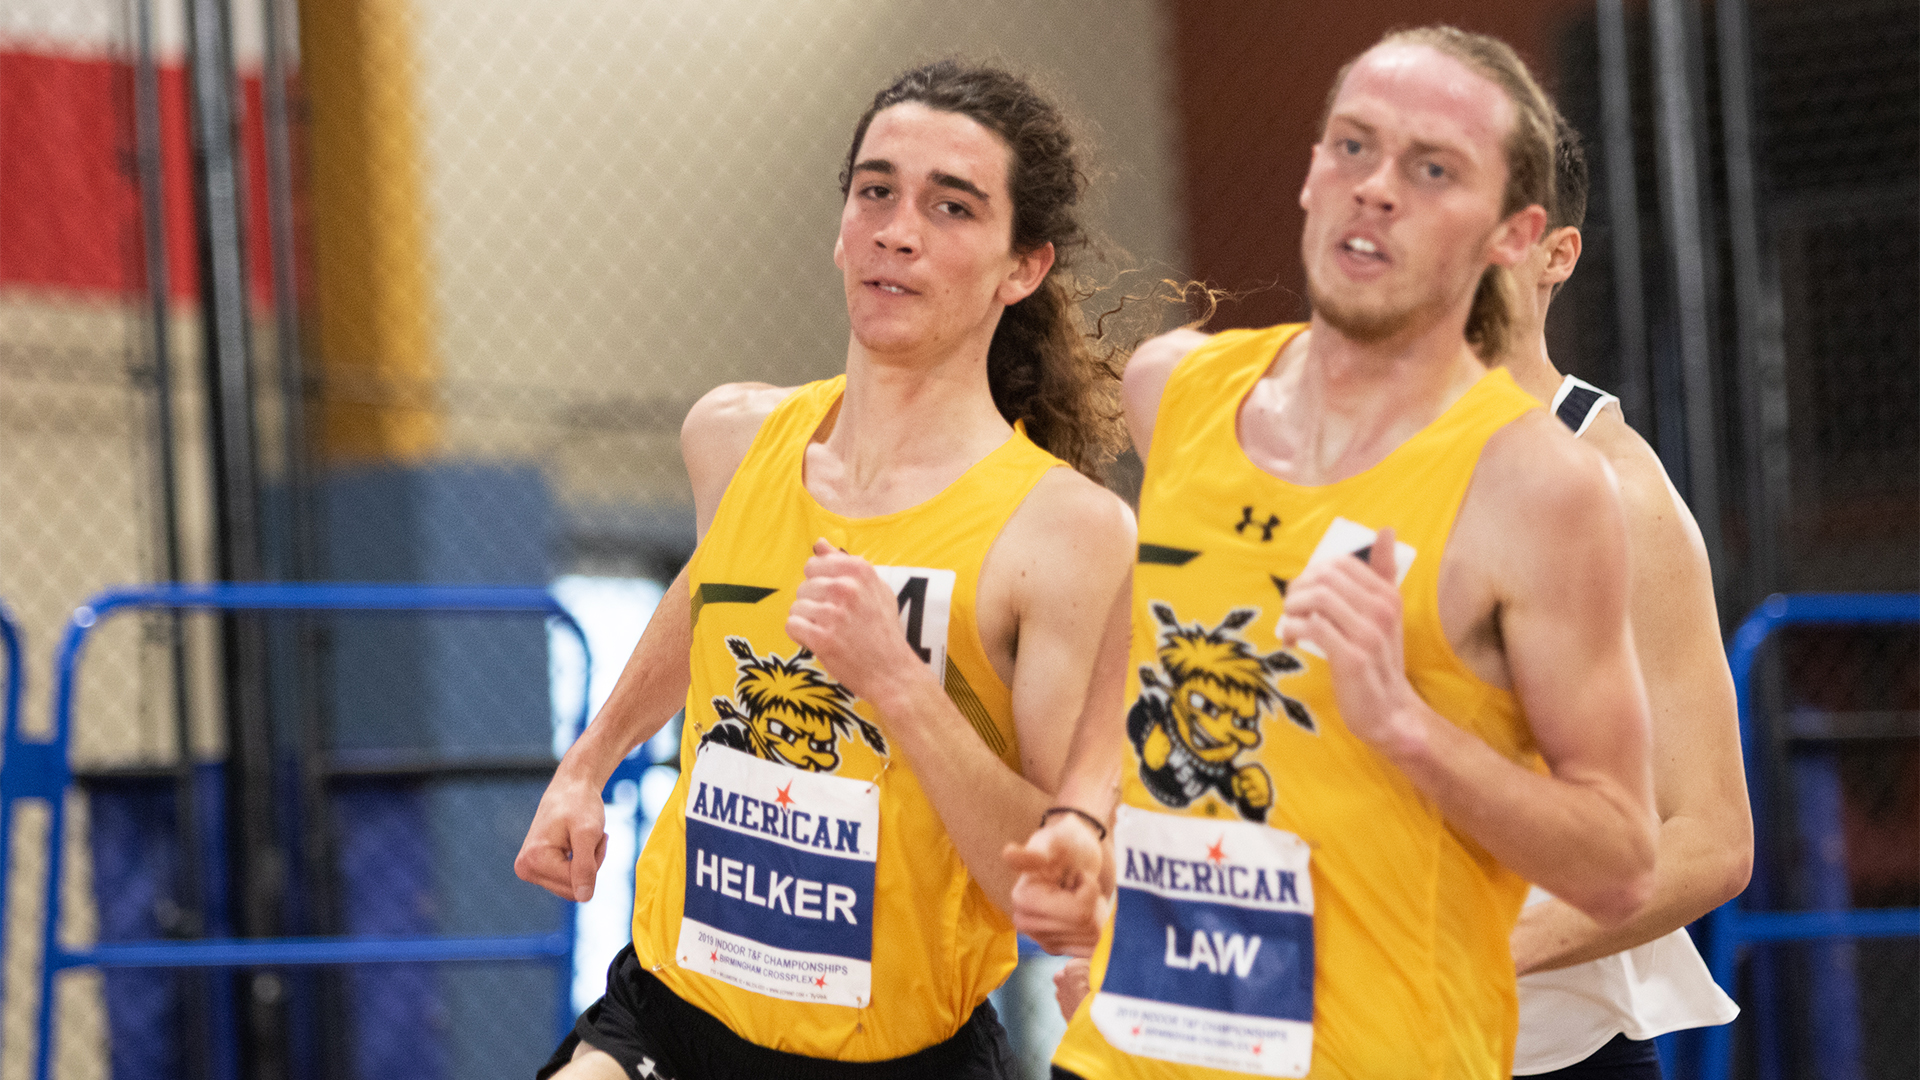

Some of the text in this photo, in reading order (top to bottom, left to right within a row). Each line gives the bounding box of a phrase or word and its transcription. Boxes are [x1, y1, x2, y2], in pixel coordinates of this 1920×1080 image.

[692, 782, 862, 854] AMERICAN
[696, 848, 858, 925] HELKER
[1125, 847, 1299, 904] AMERICAN
[698, 931, 848, 975] 2019 INDOOR T&F CHAMPIONSHIPS
[719, 954, 762, 974] BIRMINGHAM
[763, 968, 814, 984] CROSSPLEX
[1165, 925, 1261, 978] LAW
